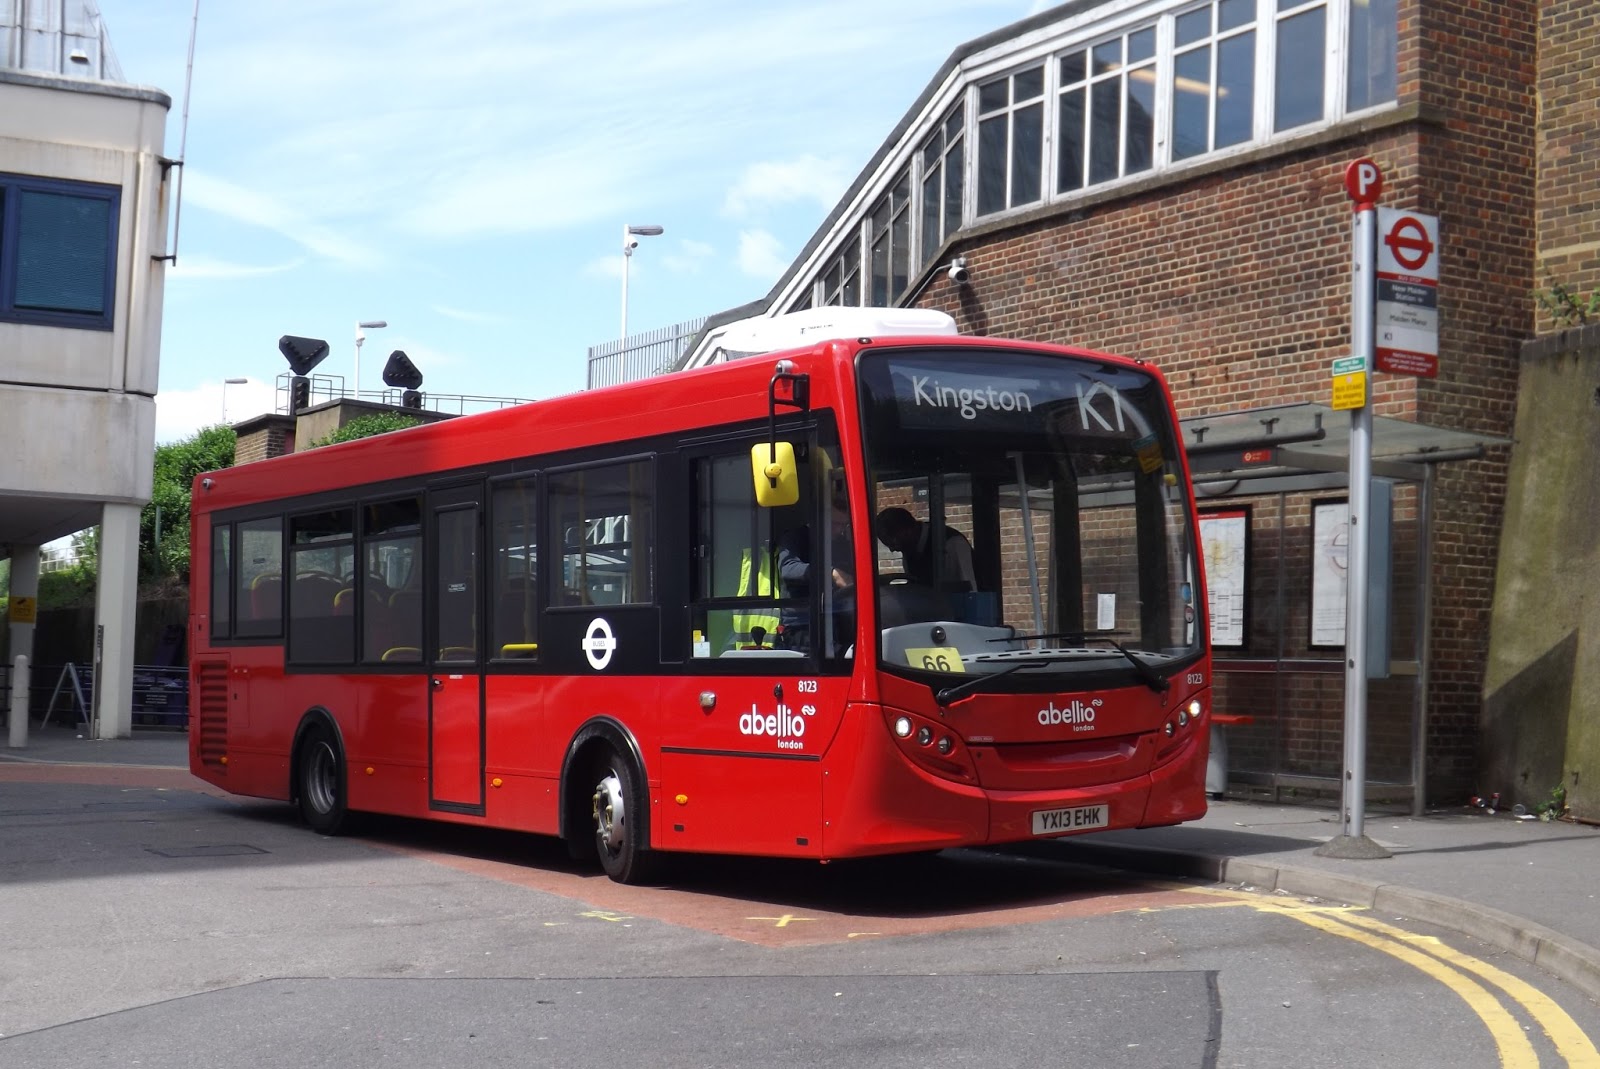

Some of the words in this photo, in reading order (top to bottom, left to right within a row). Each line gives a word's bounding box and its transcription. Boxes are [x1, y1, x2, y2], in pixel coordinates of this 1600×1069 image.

[1358, 163, 1377, 195] P
[1392, 284, 1406, 292] New
[1384, 332, 1392, 340] K1
[912, 375, 1032, 420] Kingston
[1075, 382, 1126, 433] K1
[922, 655, 951, 672] 66
[798, 680, 818, 693] 8123
[1187, 673, 1203, 685] 8123
[739, 703, 805, 738] abellio
[1037, 702, 1096, 725] abellio
[778, 739, 804, 750] london
[1041, 810, 1071, 830] YX13
[1074, 807, 1101, 826] EHK
